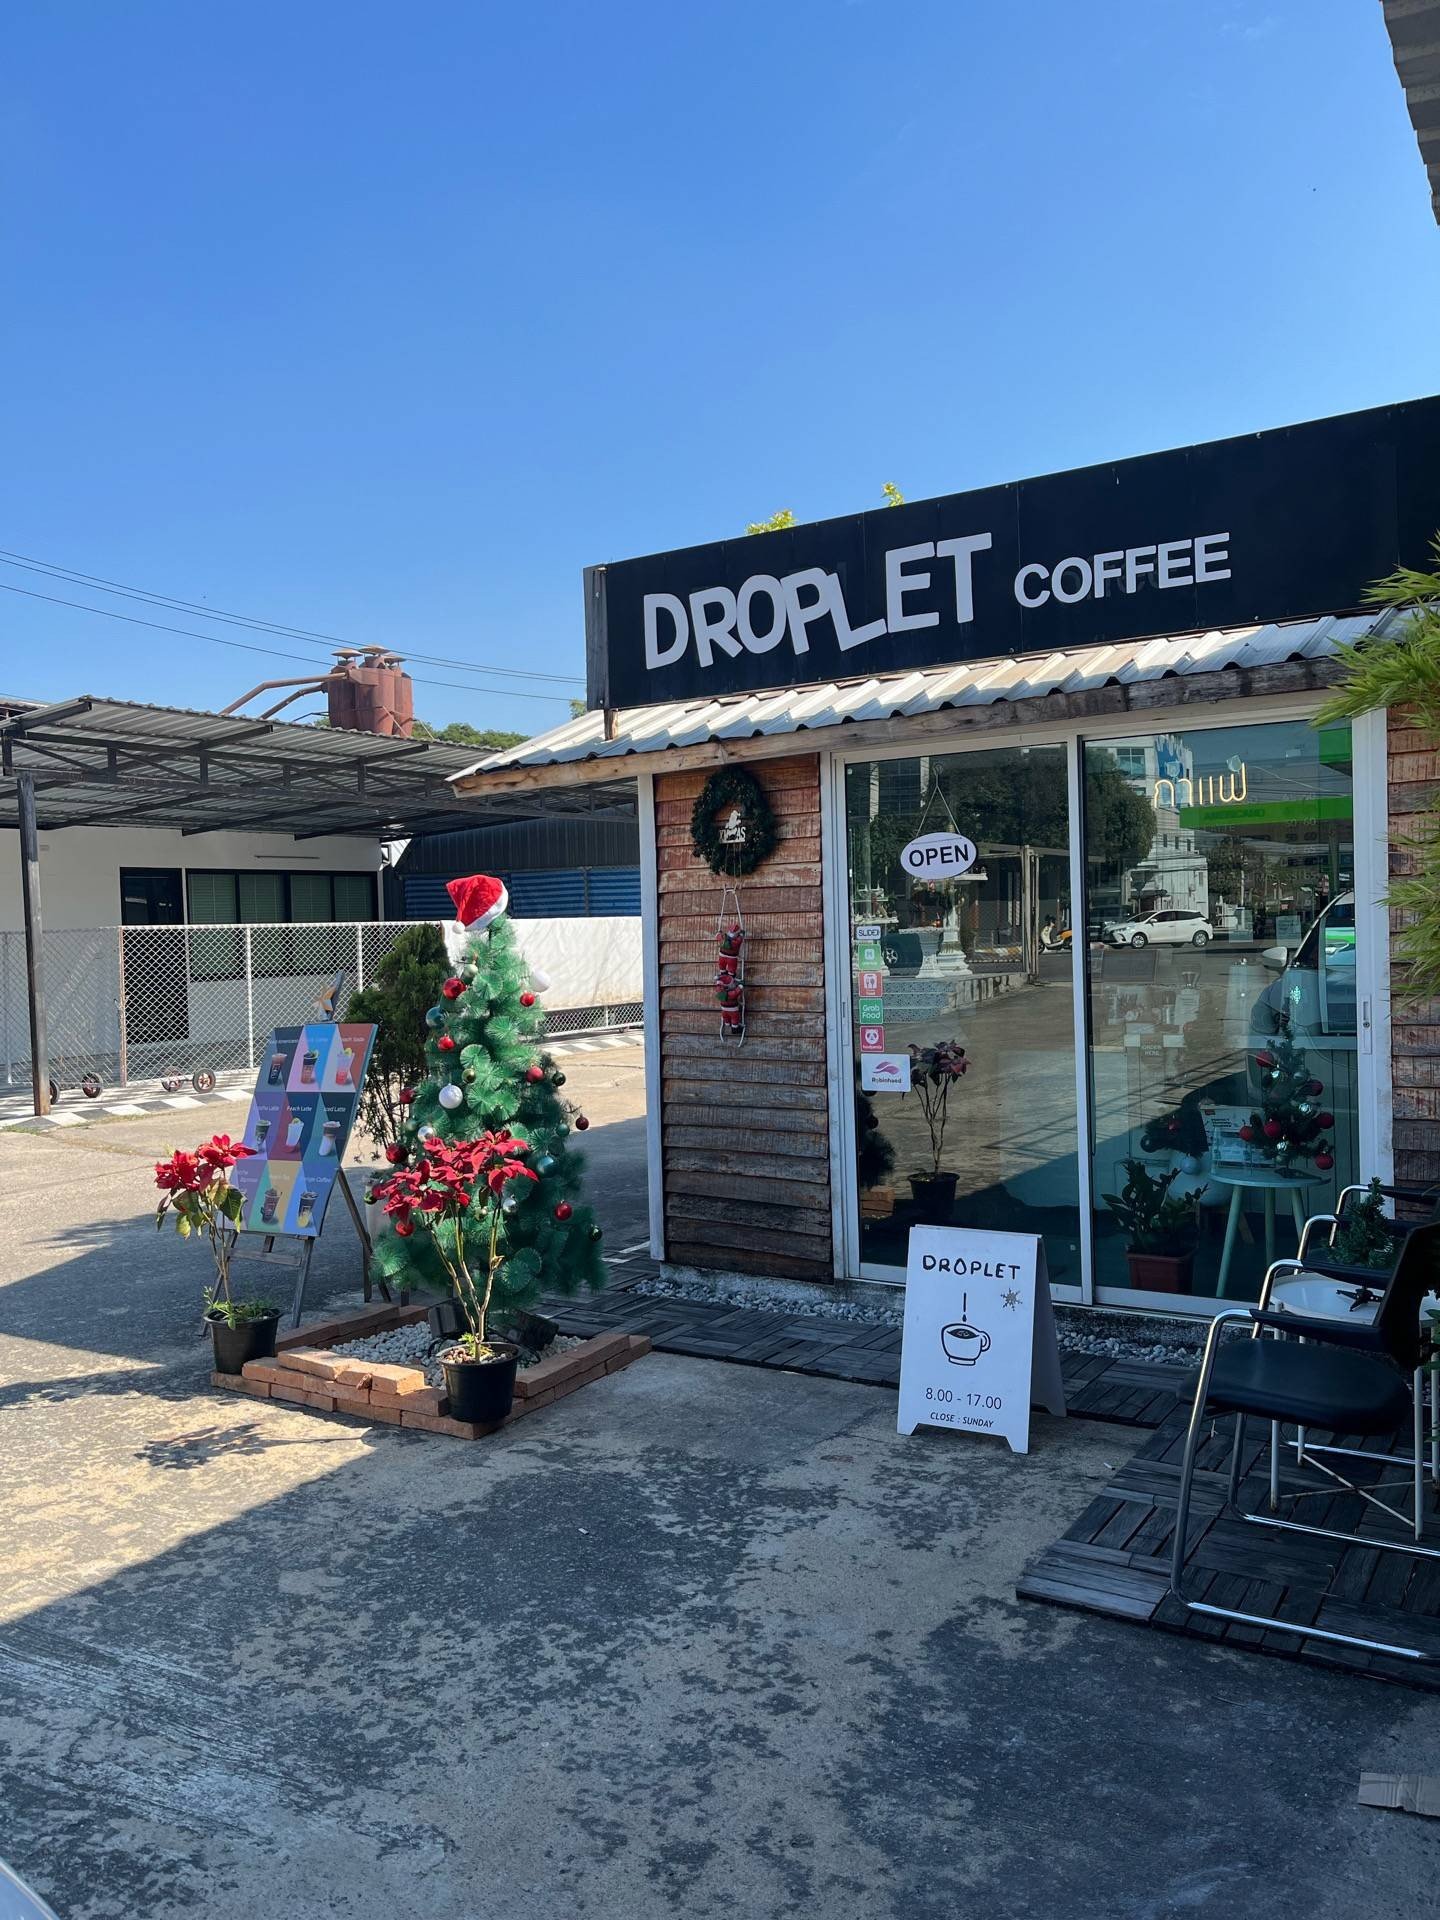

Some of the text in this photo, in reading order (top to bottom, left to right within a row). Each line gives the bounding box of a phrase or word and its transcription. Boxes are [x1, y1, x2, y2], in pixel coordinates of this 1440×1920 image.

[643, 532, 1232, 670] DROPLET COFFEE
[1153, 762, 1248, 809] กาแฟ
[908, 843, 969, 868] OPEN
[922, 1254, 1021, 1280] DROPLET
[925, 1387, 953, 1403] 8.00
[967, 1393, 1002, 1410] 17.00
[930, 1411, 955, 1423] CLOSE
[962, 1416, 994, 1428] SUNDAY
